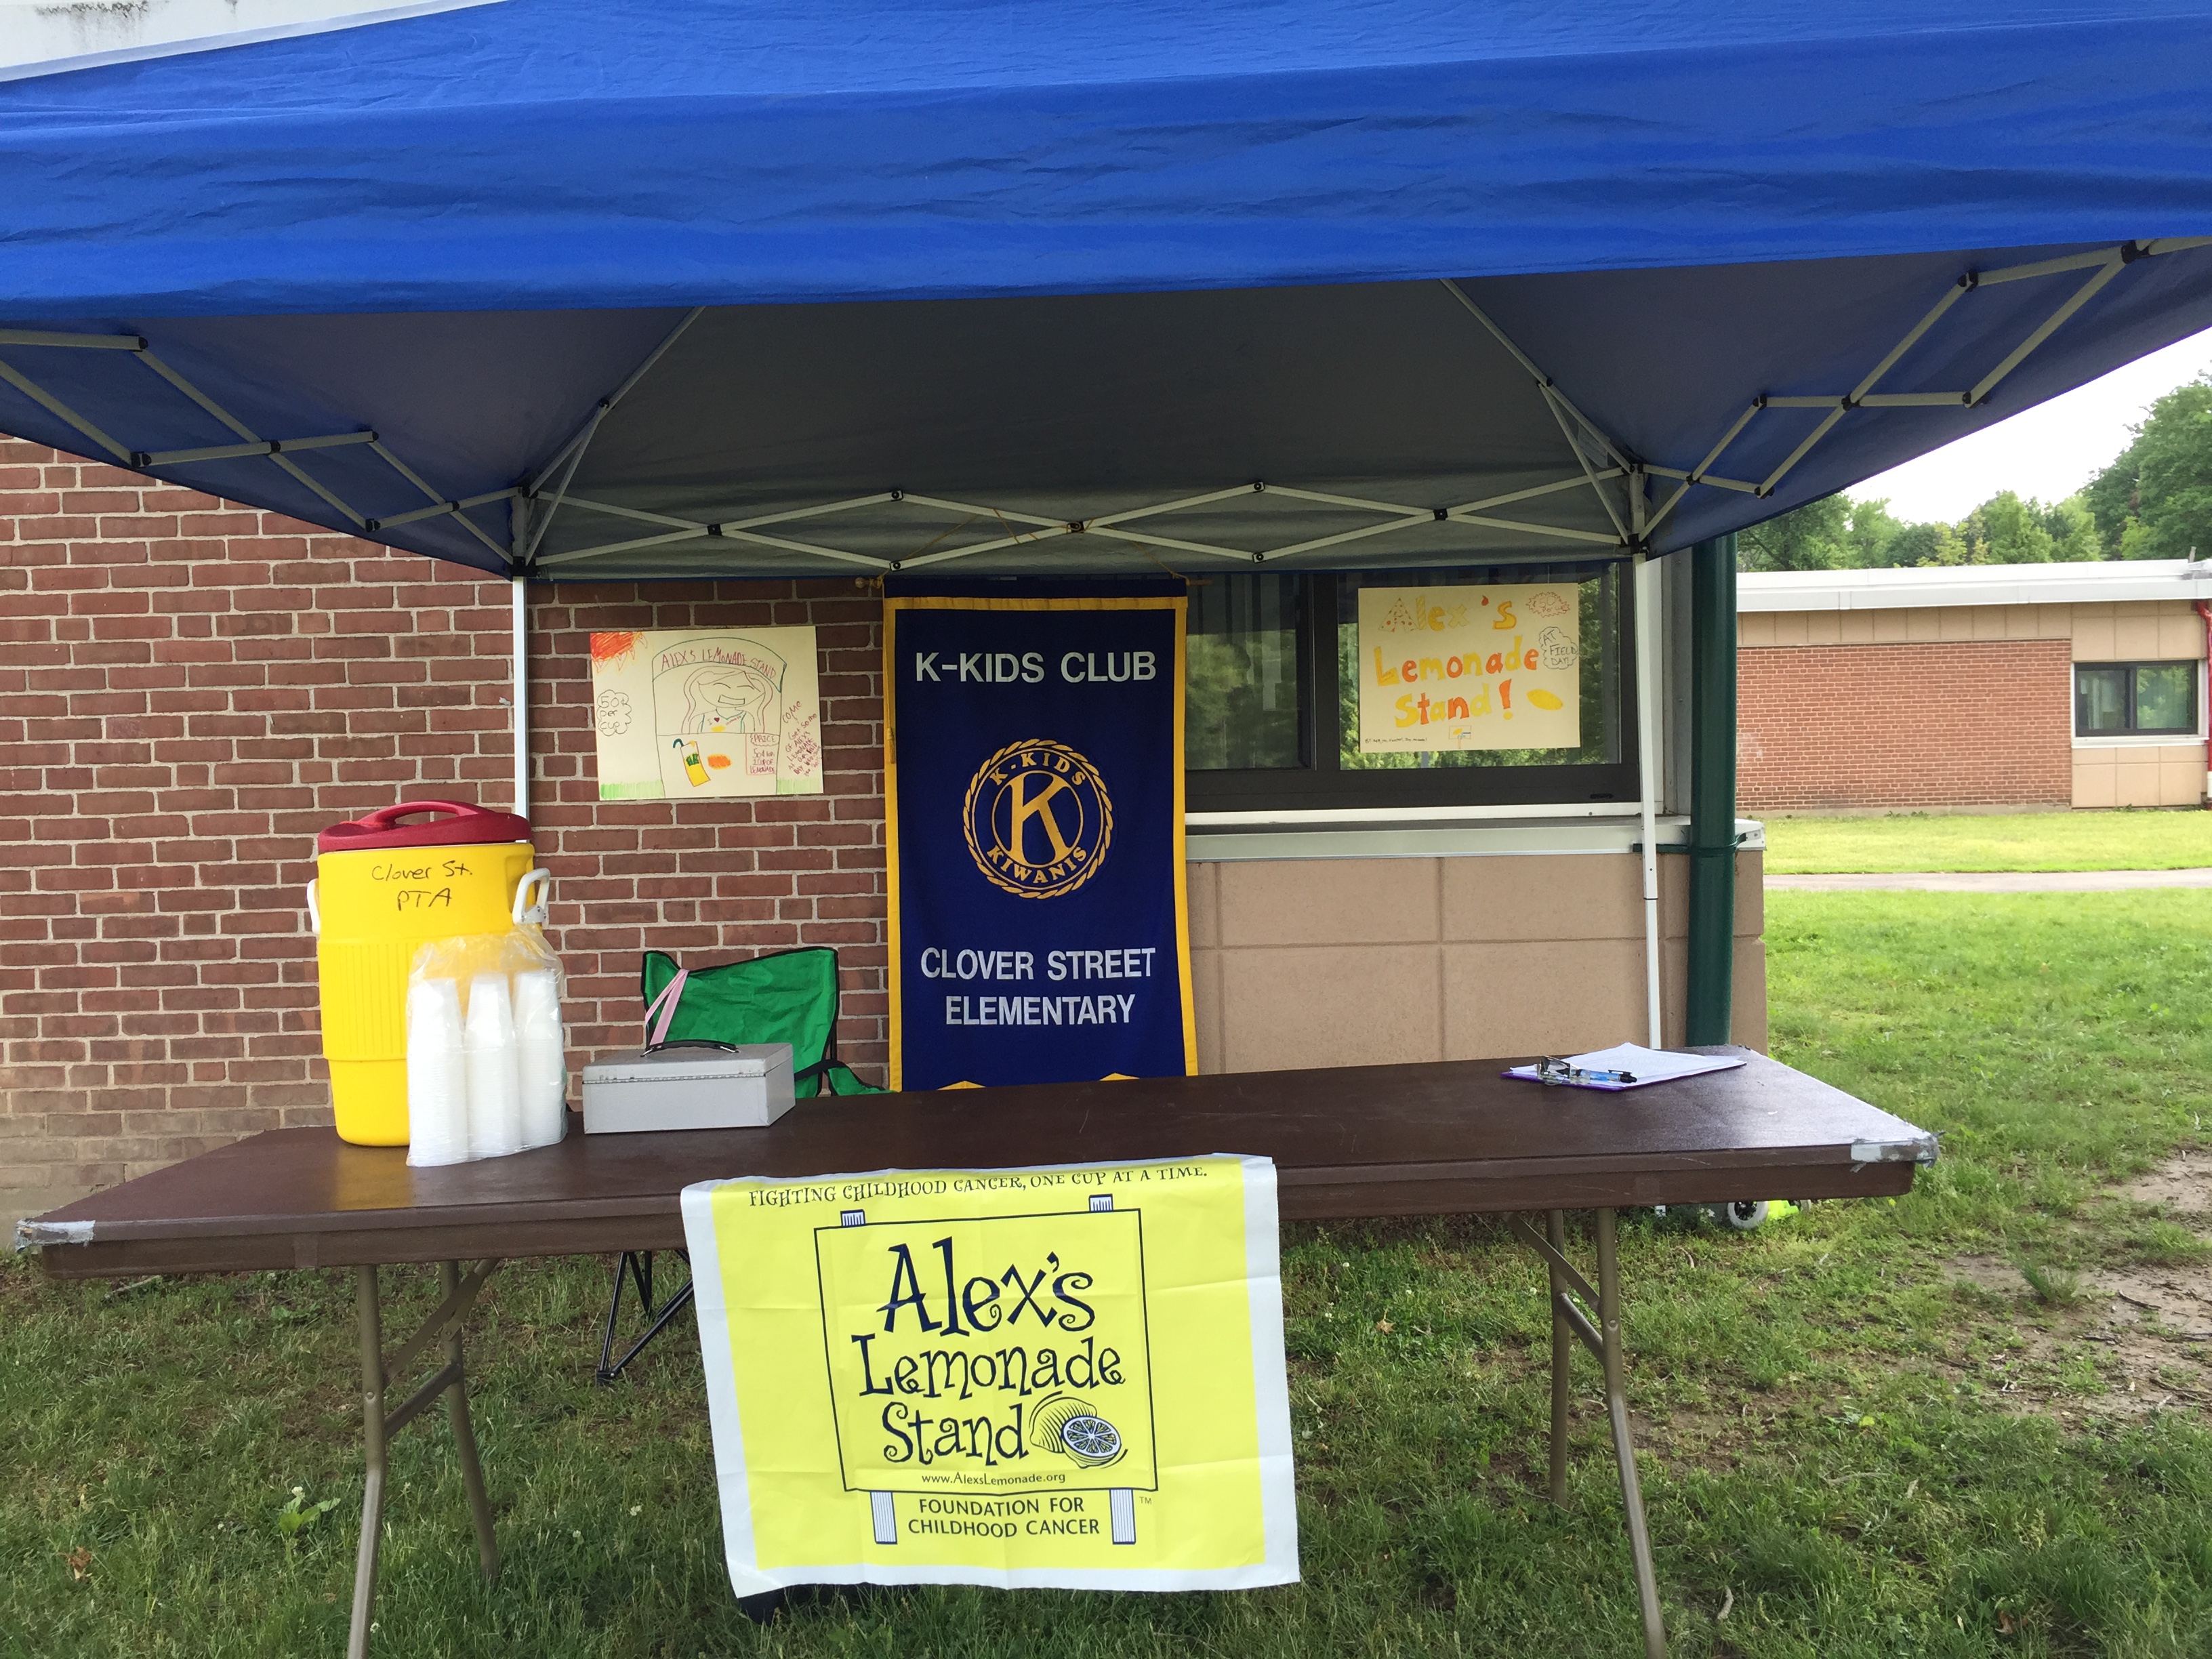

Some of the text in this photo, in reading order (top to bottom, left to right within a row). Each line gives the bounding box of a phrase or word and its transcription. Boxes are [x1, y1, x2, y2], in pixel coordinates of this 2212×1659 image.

[1543, 630, 1557, 646] AT
[1550, 644, 1576, 656] FIELD
[702, 647, 747, 665] LEMONADE
[750, 657, 777, 680] STAND
[916, 651, 1156, 683] K-KIDS CLUB
[1374, 635, 1539, 687] Lemonade
[600, 710, 618, 722] per
[600, 721, 620, 733] cup
[754, 734, 777, 743] PRICE
[1008, 771, 1071, 867] K
[371, 860, 472, 881] Clover St.
[987, 845, 1086, 883] KIWANIS
[396, 888, 453, 912] PTA
[921, 947, 1155, 981] CLOVER STREET
[945, 994, 1135, 1026] ELEMENTARY
[749, 1166, 1208, 1208] FIGHTING CHILDHOOD CANCER, ONE CUP AT A TIME.
[876, 1235, 1096, 1337] Alex's
[851, 1332, 1126, 1400] Lemonade
[882, 1401, 1029, 1466] Stand
[921, 1471, 1066, 1486] www.AlexsLemonade.org
[919, 1496, 1085, 1517] FOUNDATION FOR
[908, 1519, 1100, 1538] CHILDHOOD CANCER
